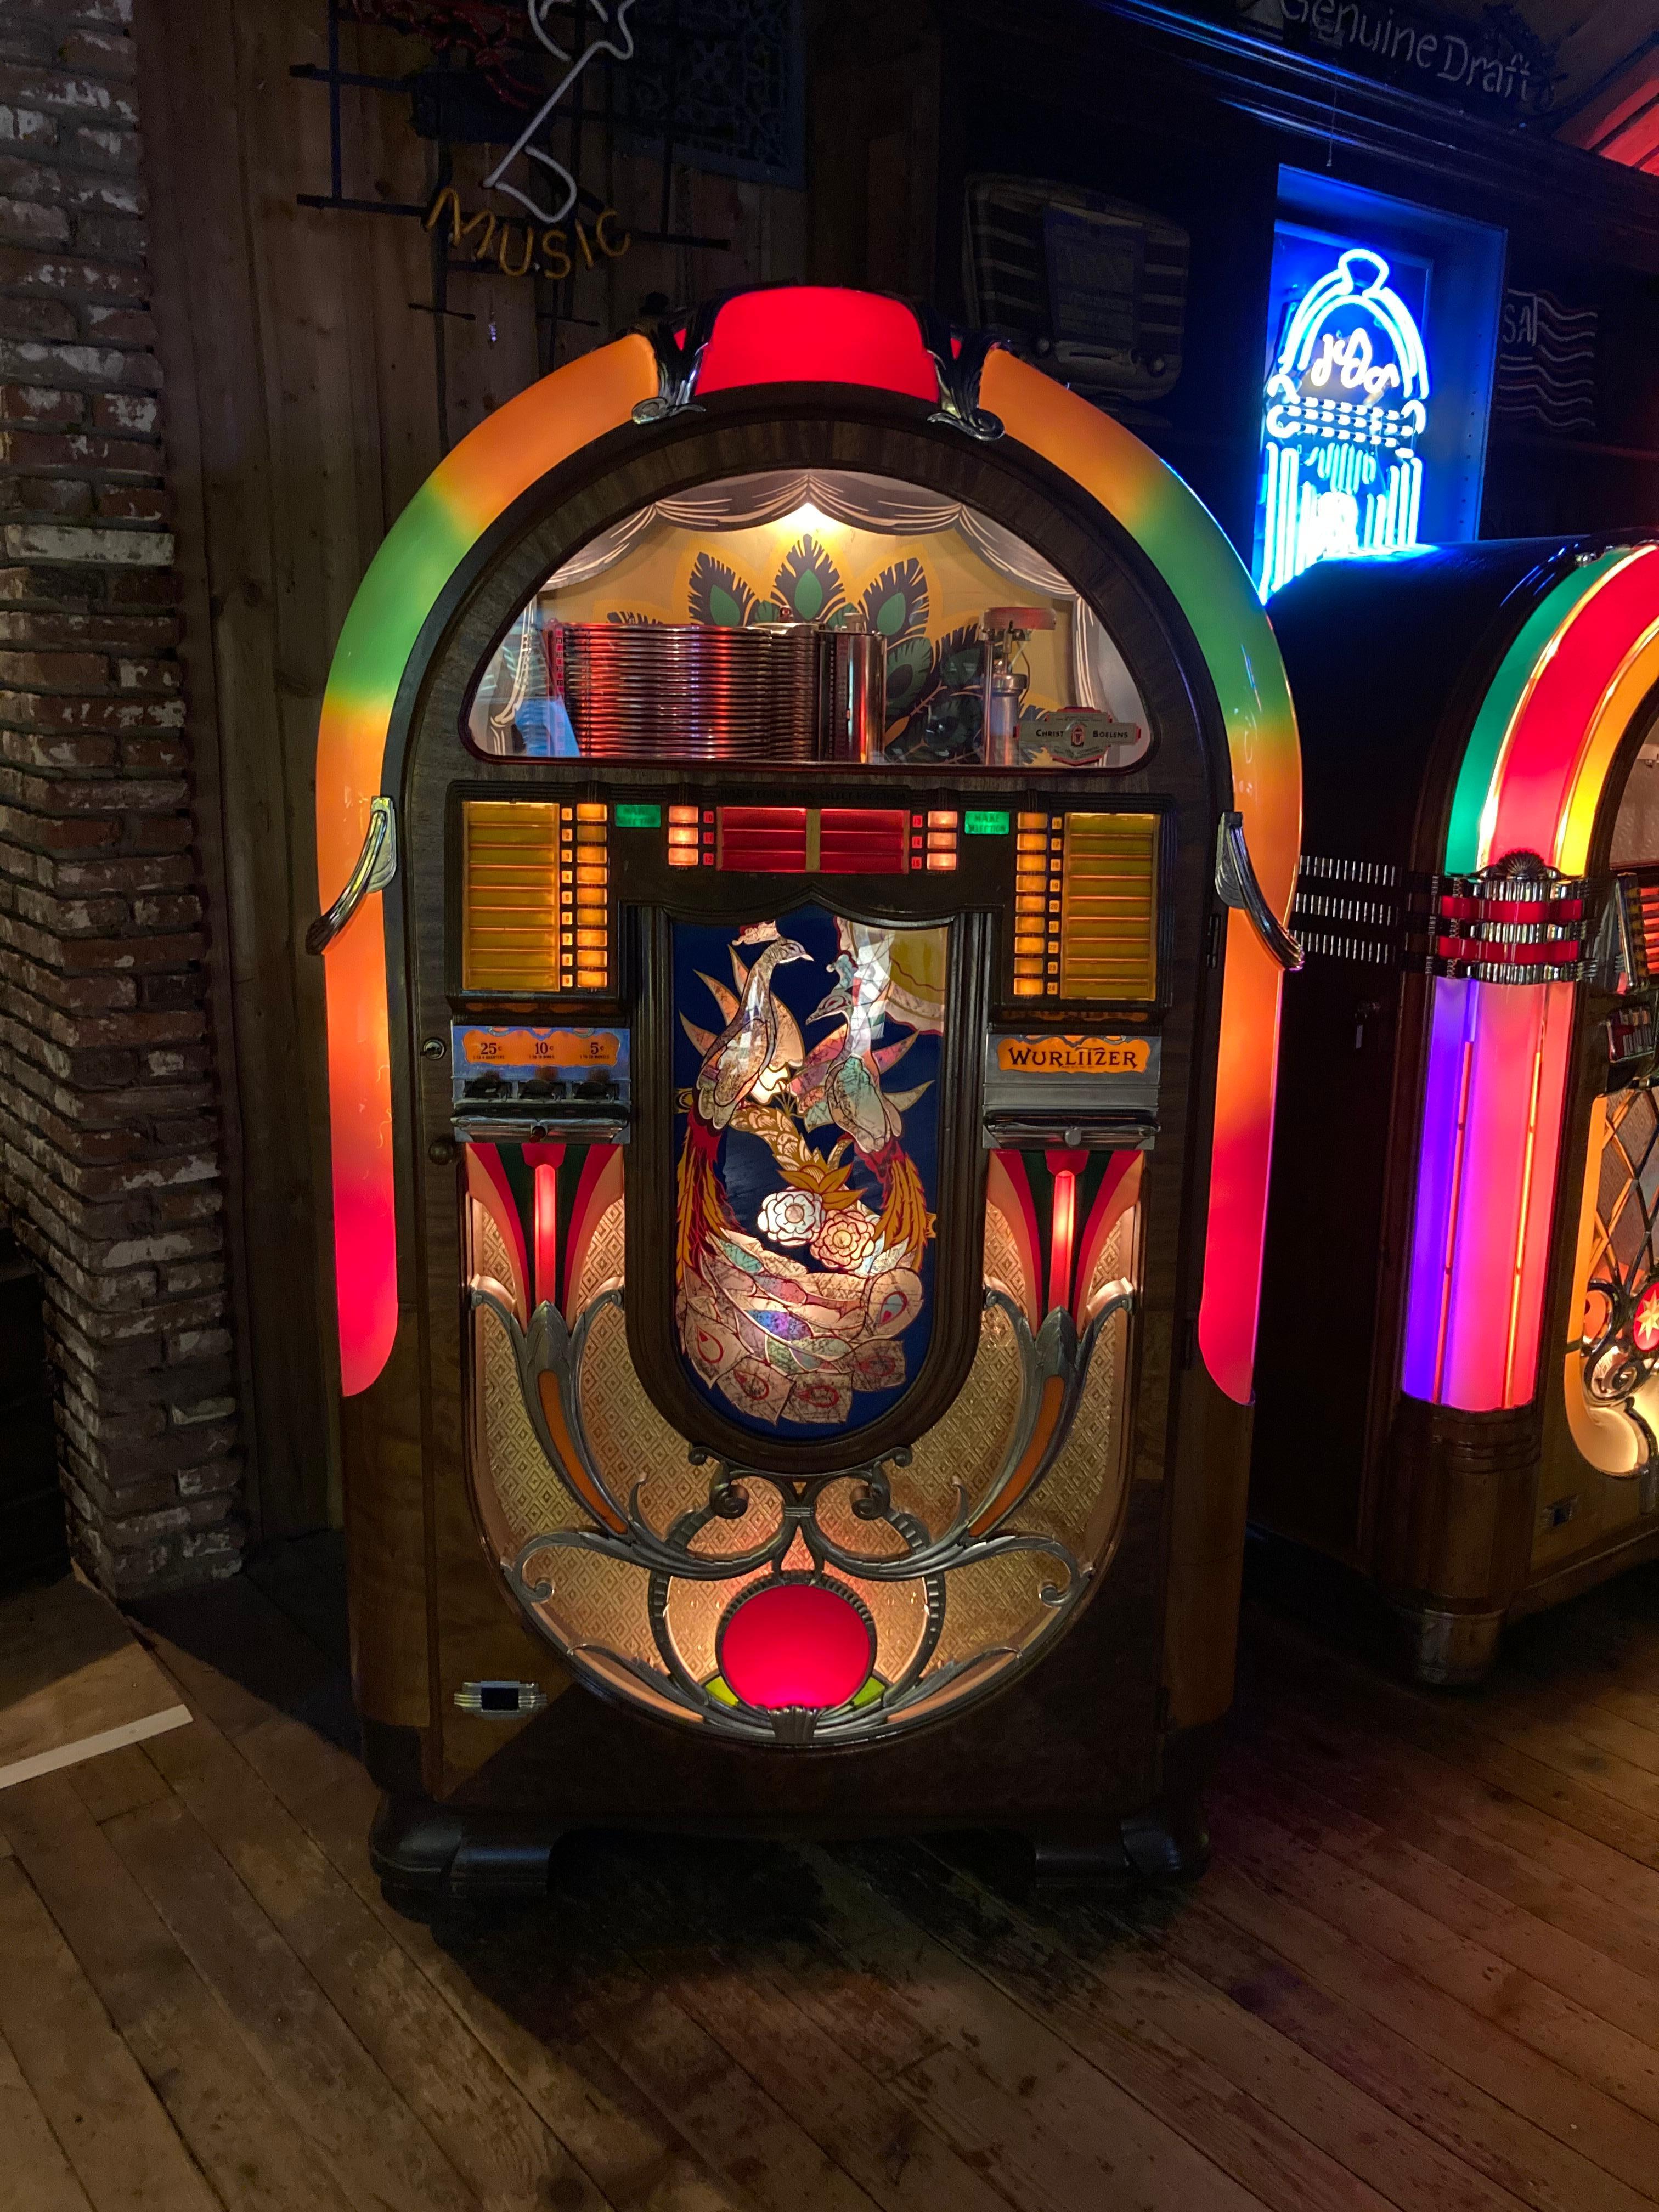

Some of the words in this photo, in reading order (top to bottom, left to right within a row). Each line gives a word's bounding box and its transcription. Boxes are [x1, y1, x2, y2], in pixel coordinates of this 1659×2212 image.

[1280, 0, 1438, 68] Genuine
[1437, 35, 1531, 101] Draft
[1503, 303, 1531, 343] SA
[1036, 729, 1064, 738] CHRIST
[1092, 730, 1128, 738] BOELENS
[1008, 1046, 1137, 1068] WURLITZER
